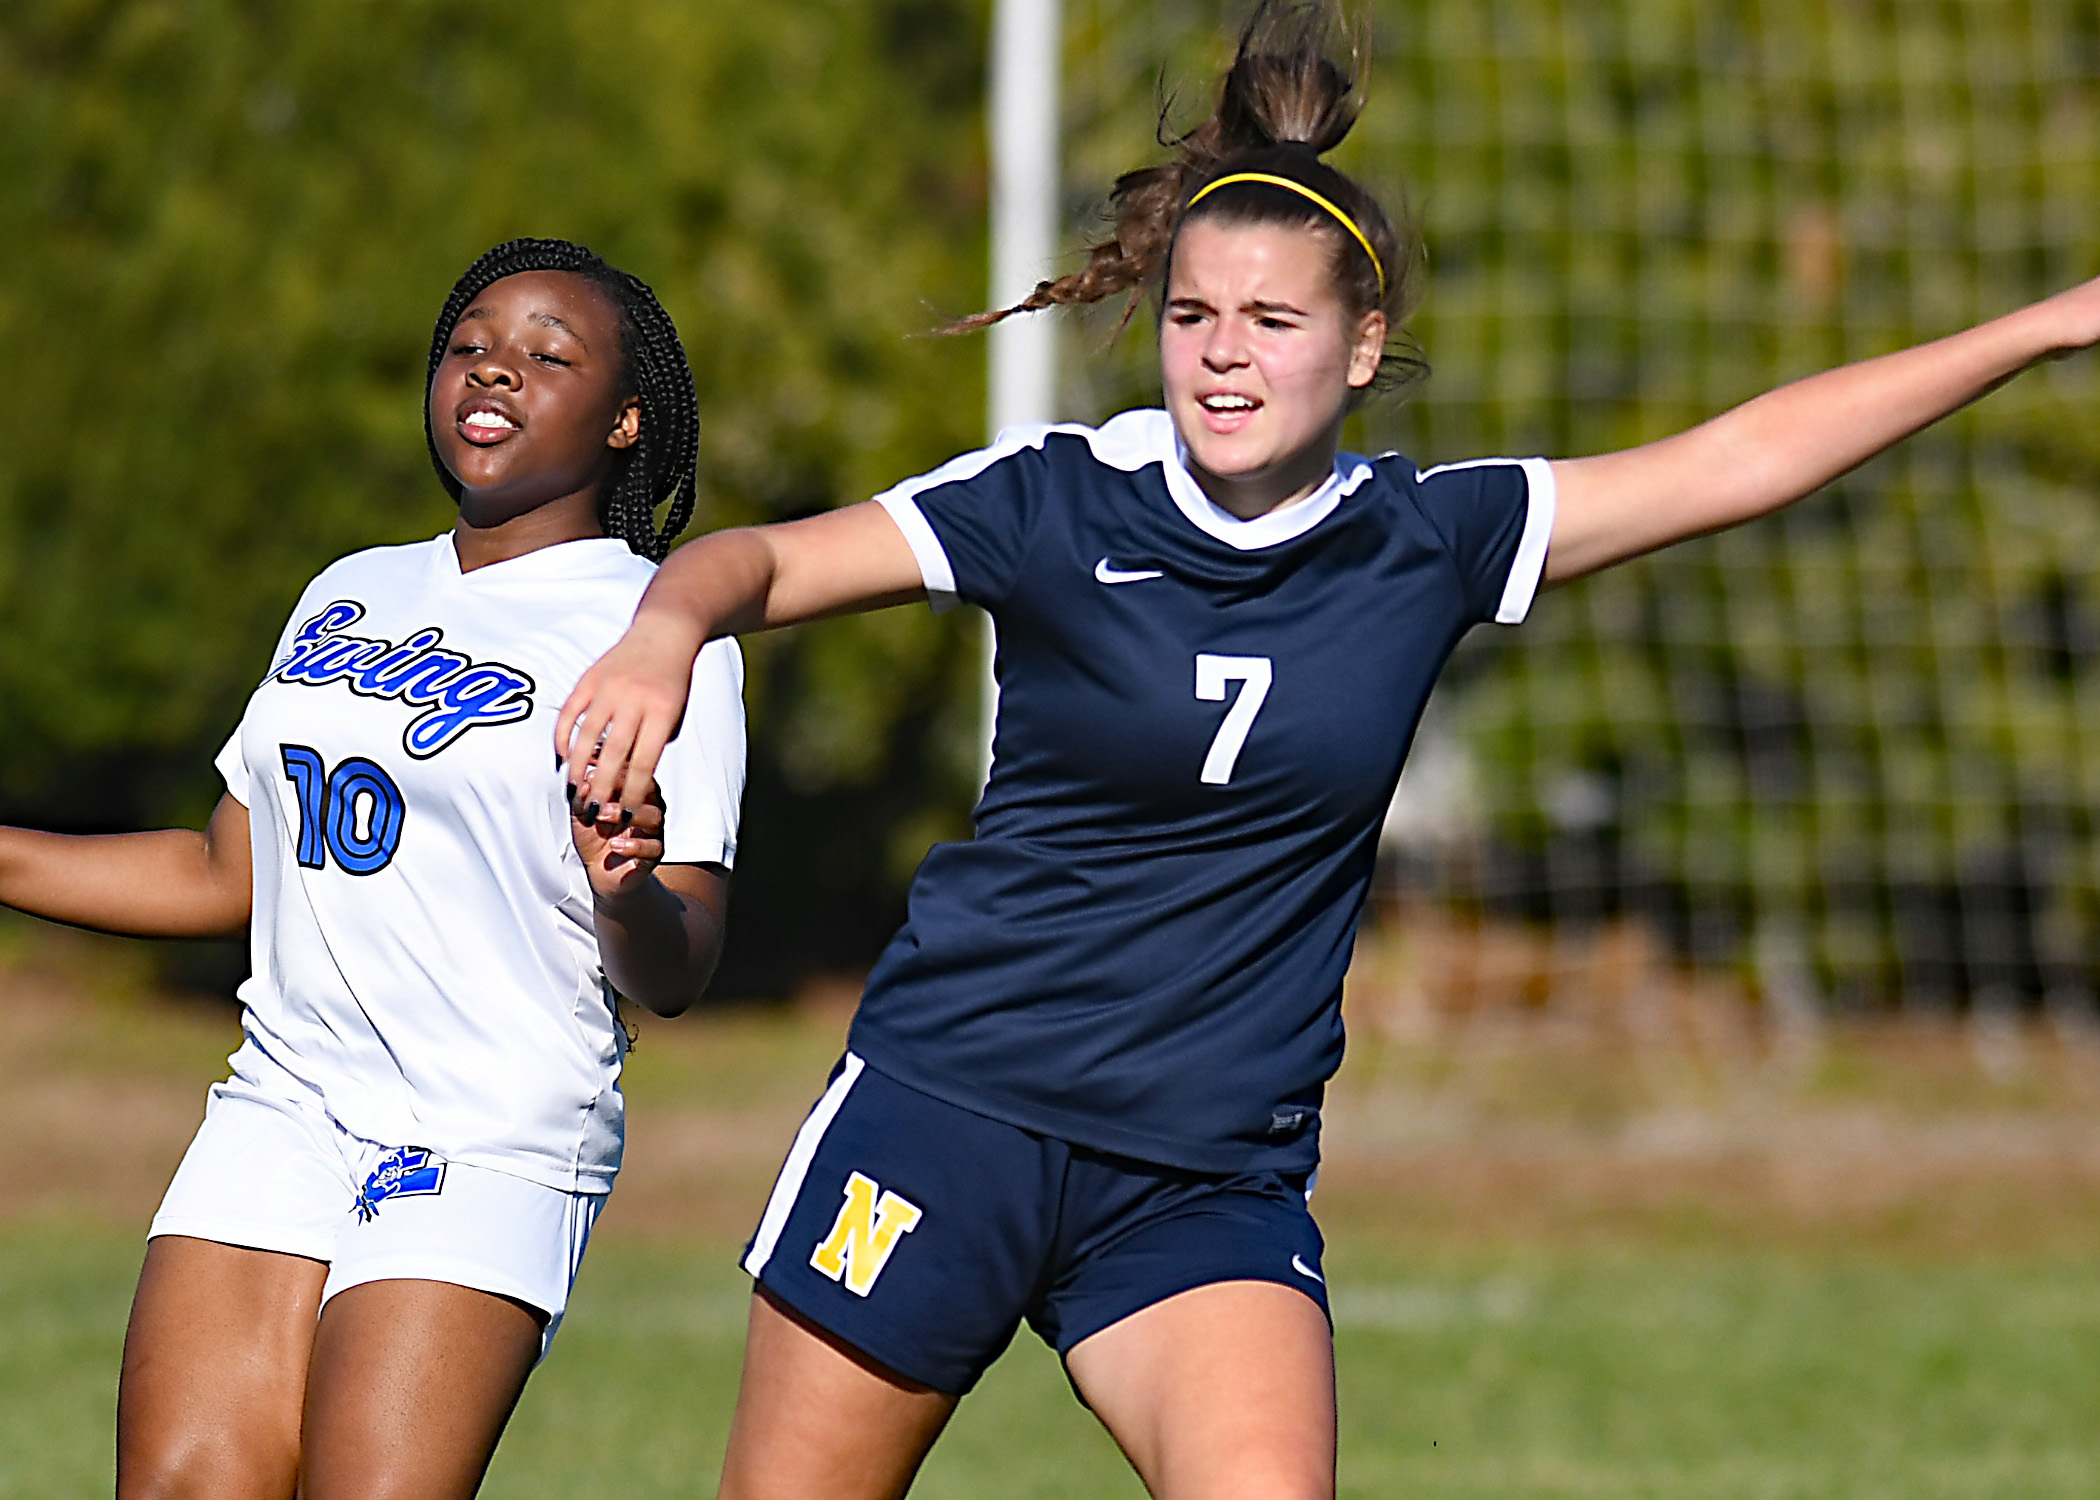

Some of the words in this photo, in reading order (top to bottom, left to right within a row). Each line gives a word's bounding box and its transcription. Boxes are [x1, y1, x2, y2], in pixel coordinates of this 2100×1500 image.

[257, 599, 536, 760] Ewing
[1195, 653, 1272, 784] 7
[279, 743, 406, 877] 10
[809, 1170, 922, 1297] N
